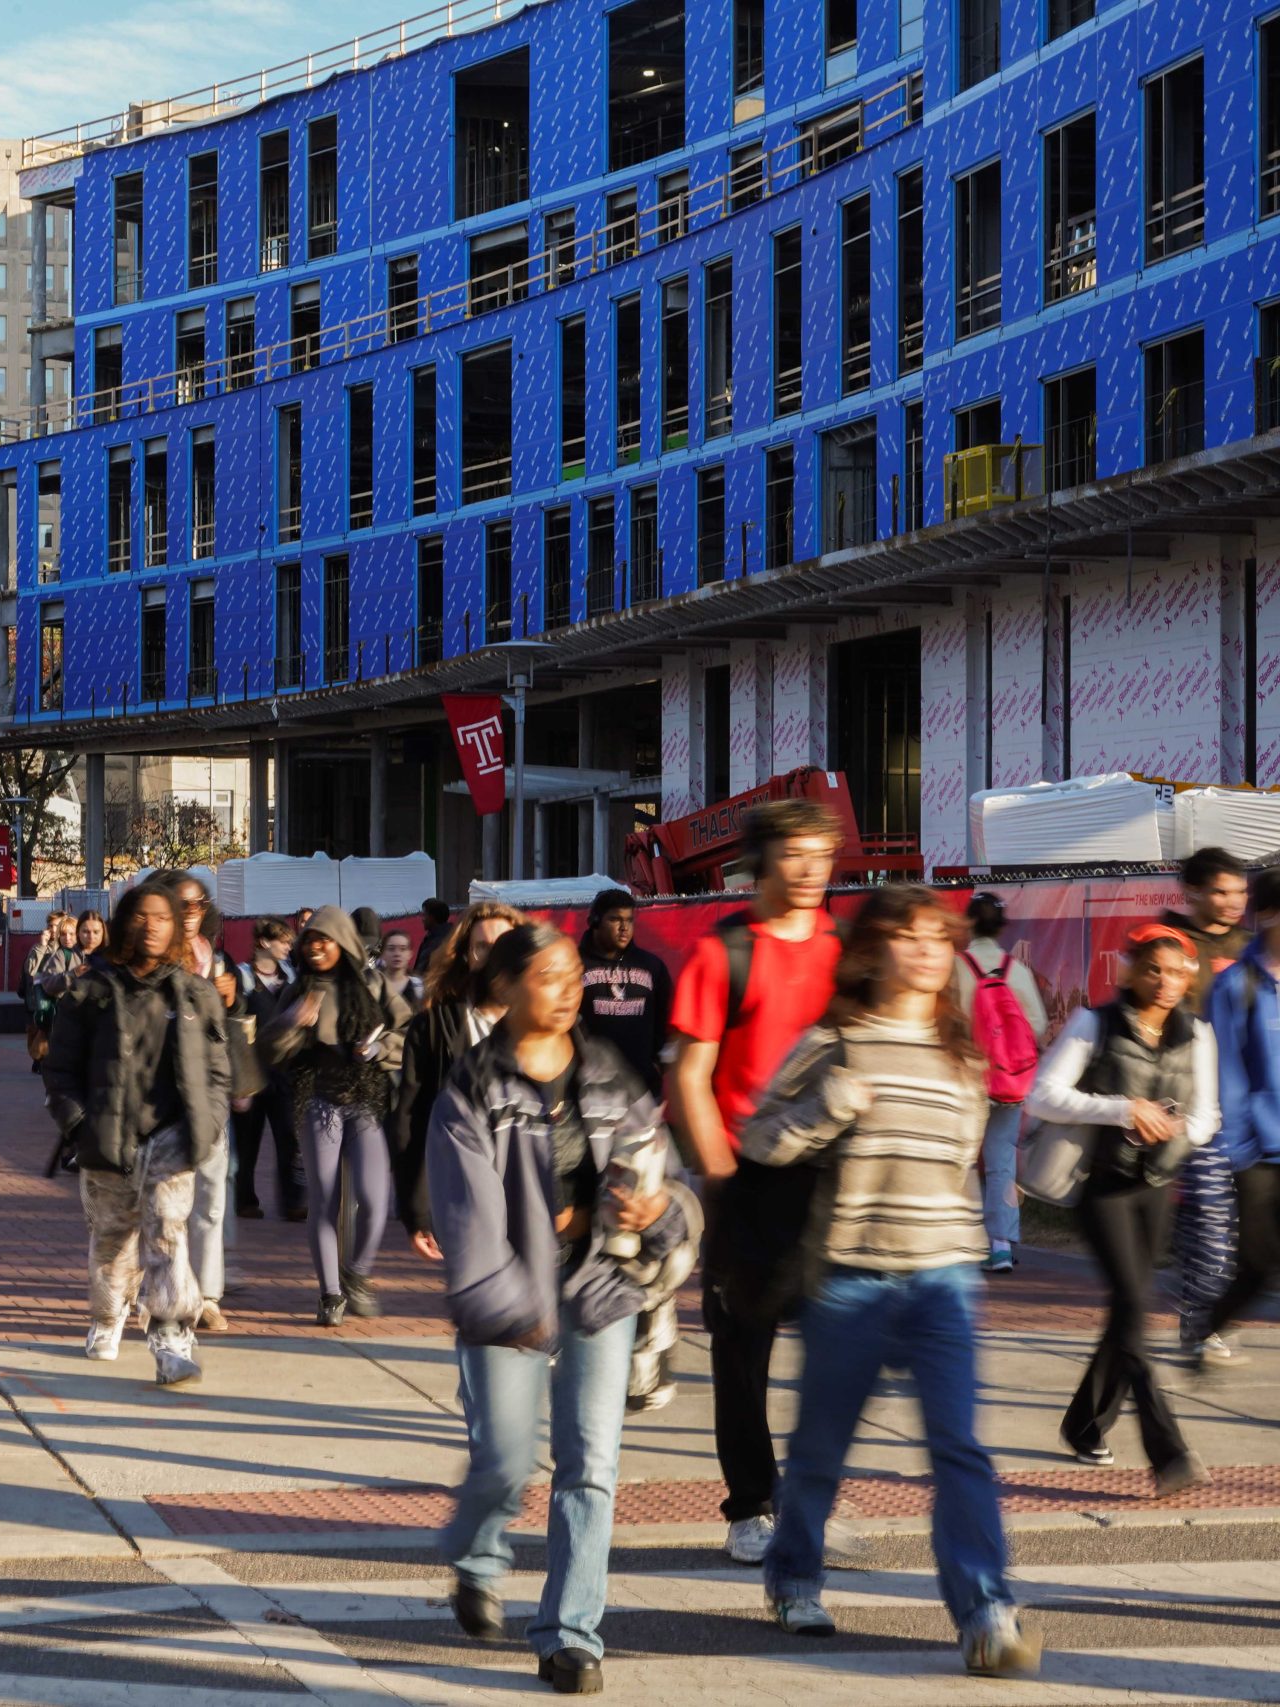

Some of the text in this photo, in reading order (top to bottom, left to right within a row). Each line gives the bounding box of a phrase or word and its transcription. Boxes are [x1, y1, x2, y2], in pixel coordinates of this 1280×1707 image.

[456, 715, 503, 776] T
[1135, 894, 1148, 906] THE
[1150, 894, 1165, 906] NEW
